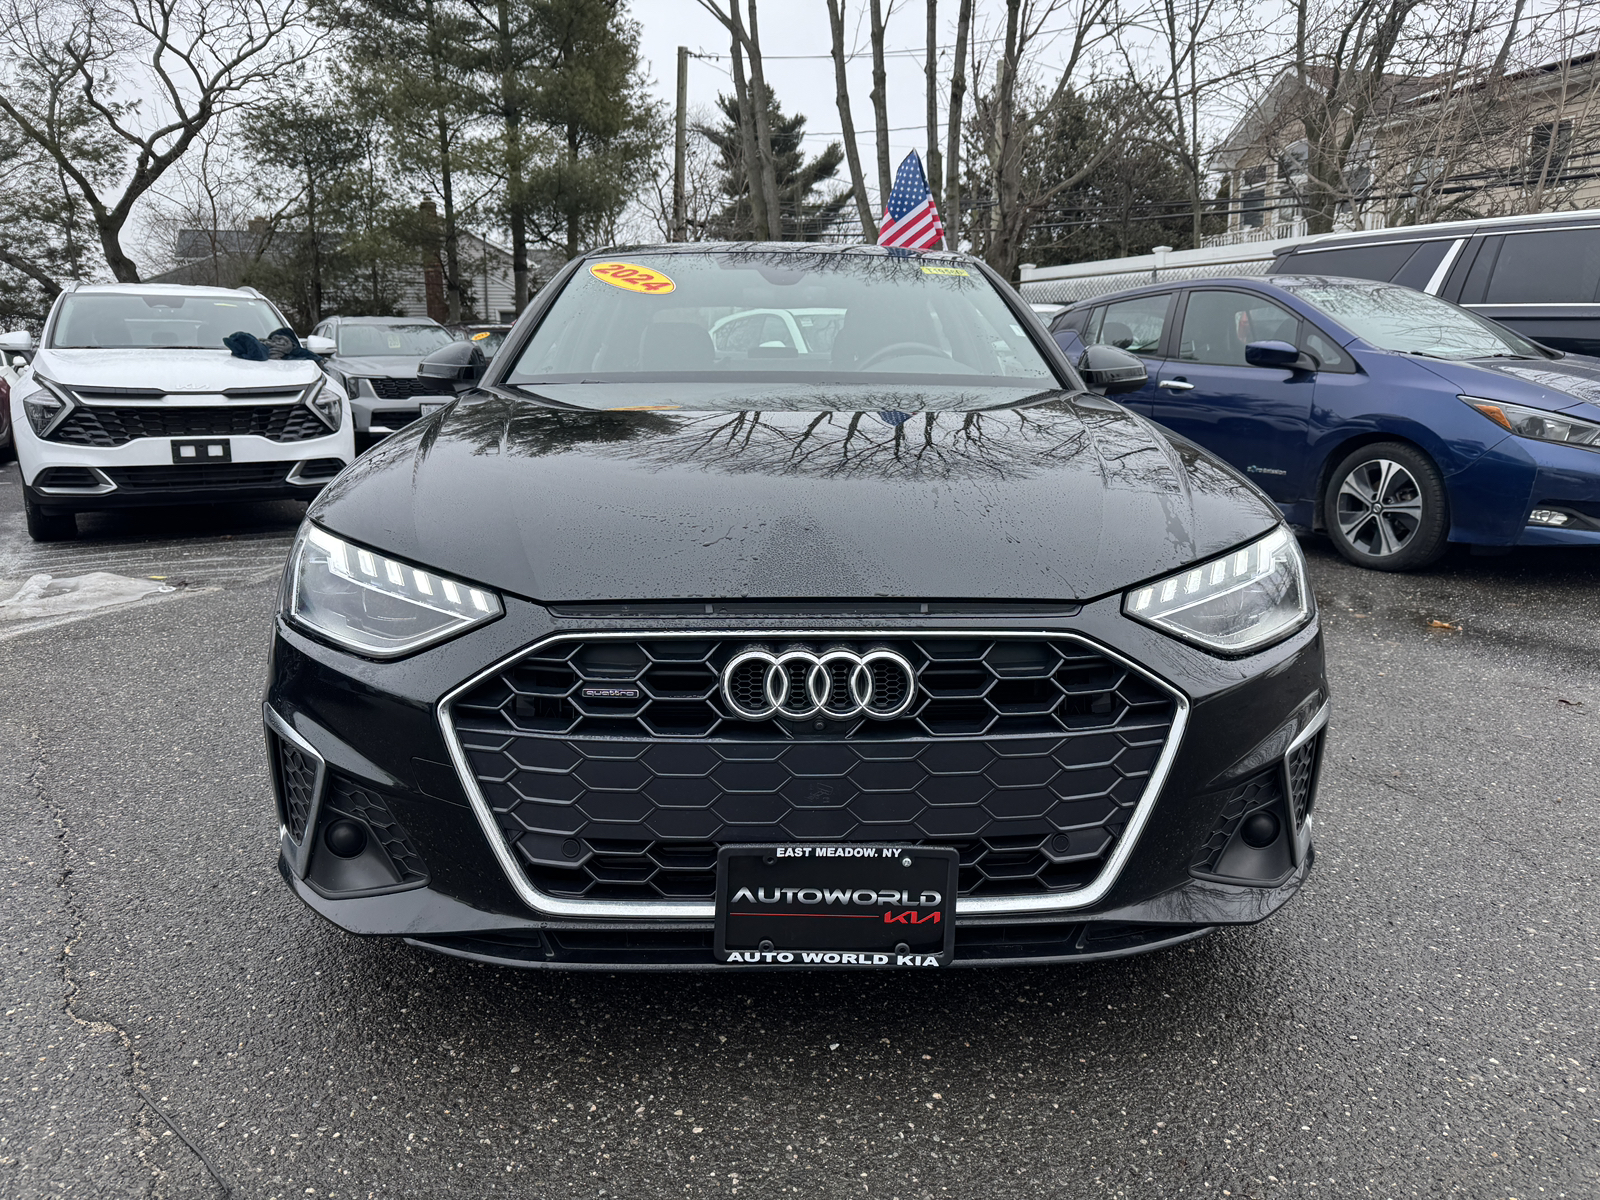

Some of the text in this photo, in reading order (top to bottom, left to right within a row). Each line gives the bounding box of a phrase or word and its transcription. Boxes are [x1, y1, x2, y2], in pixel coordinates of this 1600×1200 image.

[594, 264, 672, 291] 2024
[776, 847, 812, 858] EAST
[882, 848, 902, 858] NY
[730, 886, 943, 907] AUTOWORLD
[883, 910, 941, 924] KIA
[726, 952, 940, 967] AUTO WORLD KIA
